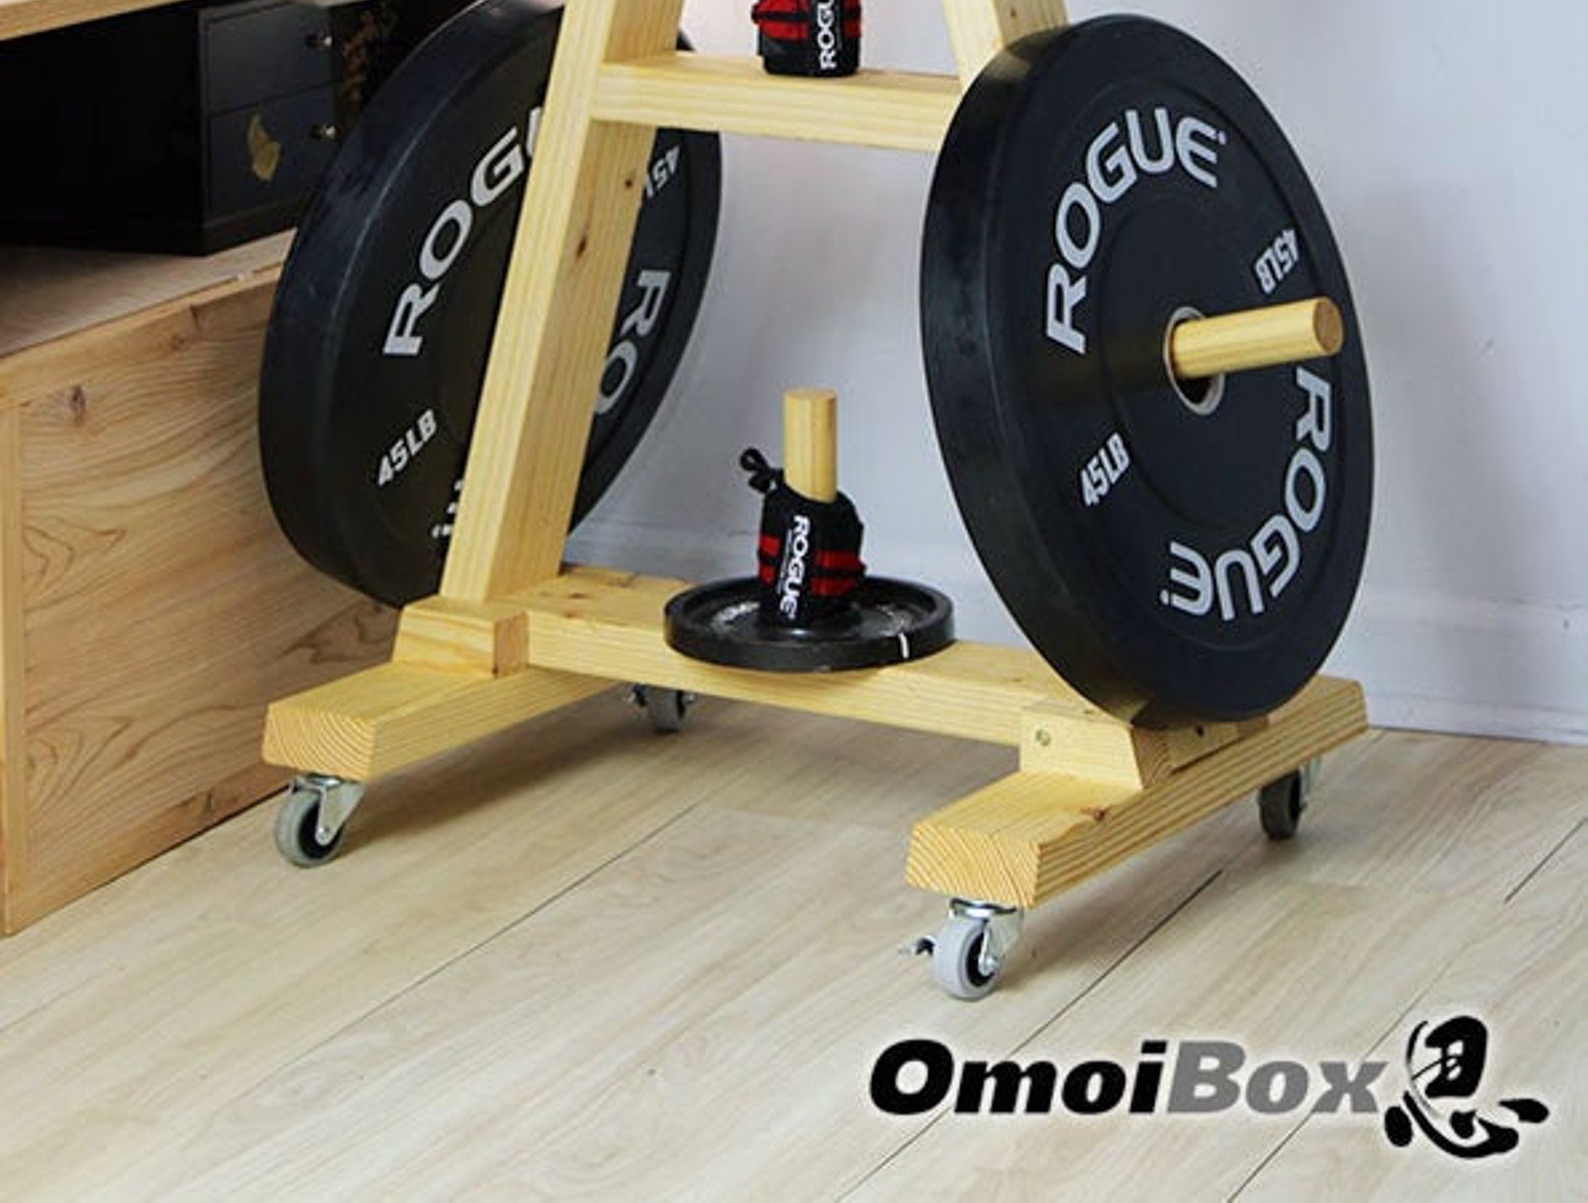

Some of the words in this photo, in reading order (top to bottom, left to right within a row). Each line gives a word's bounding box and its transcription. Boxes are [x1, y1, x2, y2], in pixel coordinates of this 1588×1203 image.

[384, 106, 542, 356] ROG
[1046, 107, 1227, 354] ROGUE
[1255, 229, 1299, 294] 45LB
[377, 409, 438, 487] 45LB
[1080, 433, 1130, 506] 45LB
[1161, 366, 1331, 620] ROGUE
[780, 515, 810, 620] ROGUE
